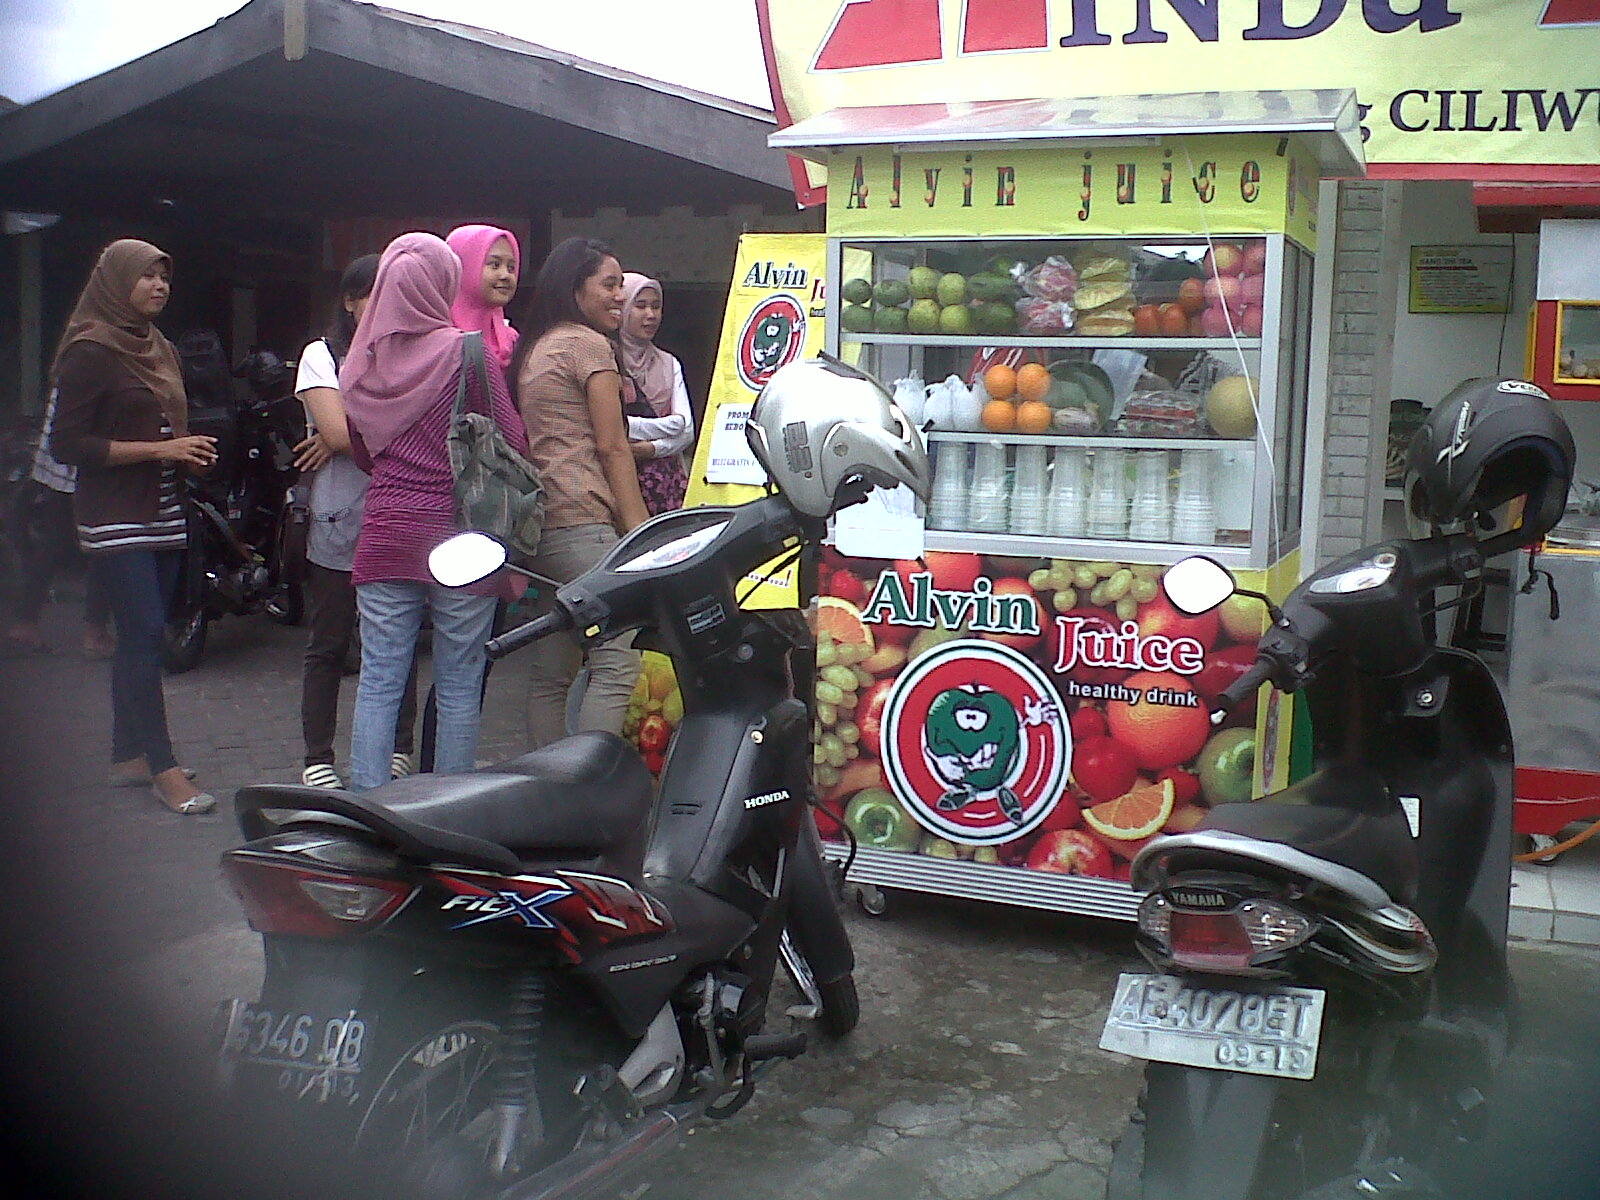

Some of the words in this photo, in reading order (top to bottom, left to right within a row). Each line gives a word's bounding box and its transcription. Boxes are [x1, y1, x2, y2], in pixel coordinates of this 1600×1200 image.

[1389, 88, 1600, 133] CILIW
[846, 153, 1016, 209] Alvin
[1077, 148, 1260, 221] juice
[742, 261, 807, 289] Alvin
[862, 571, 1039, 635] Alvin
[1054, 616, 1205, 674] Juice
[1069, 681, 1140, 706] healthy
[1146, 687, 1198, 707] drink
[744, 790, 790, 809] HONDA
[1171, 891, 1227, 907] YAMAHA
